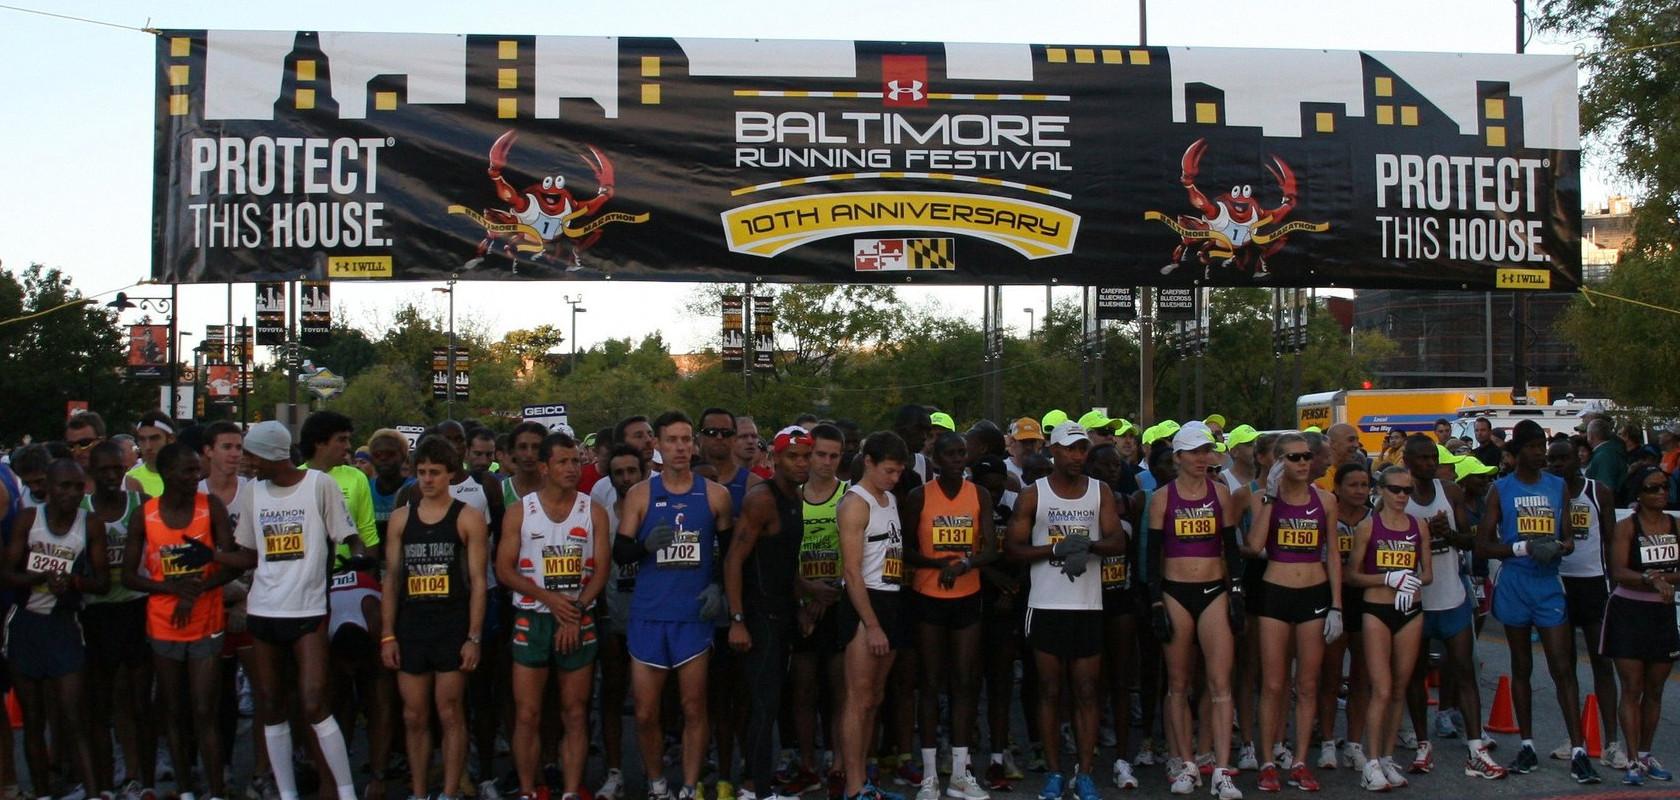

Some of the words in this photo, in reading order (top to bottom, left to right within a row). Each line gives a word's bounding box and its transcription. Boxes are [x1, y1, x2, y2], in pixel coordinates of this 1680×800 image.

[735, 111, 1071, 147] BALTIMORE
[735, 148, 891, 168] RUNNING
[906, 149, 1072, 171] FESTIVAL
[188, 202, 262, 248] THIS
[272, 202, 393, 248] HOUSE.
[464, 208, 518, 232] BALTIMORE
[583, 214, 636, 234] MARATHON
[741, 208, 820, 236] 10TH
[831, 202, 1060, 237] ANNIVERSARY
[542, 222, 550, 234] 1
[1160, 214, 1210, 238] BALTIMORE
[1268, 222, 1317, 240] MARATHON
[1232, 228, 1238, 240] 1
[1376, 216, 1440, 260] THIS
[1449, 218, 1551, 262] HOUSE.
[524, 405, 565, 416] GEICO
[1301, 407, 1329, 420] PENSKE
[1380, 425, 1392, 434] Way
[1514, 496, 1549, 508] PUMA
[260, 509, 304, 518] MARATHON
[1181, 520, 1210, 533] F138
[1520, 518, 1551, 531] M111
[939, 529, 966, 542] F131
[1284, 531, 1312, 544] F150
[267, 535, 300, 552] M120
[429, 542, 455, 557] TRACK
[664, 545, 695, 560] 1702
[1382, 552, 1411, 566] F128
[1646, 546, 1675, 560] 1170
[33, 555, 68, 571] 3294
[546, 558, 580, 573] M106
[410, 578, 445, 592] M104
